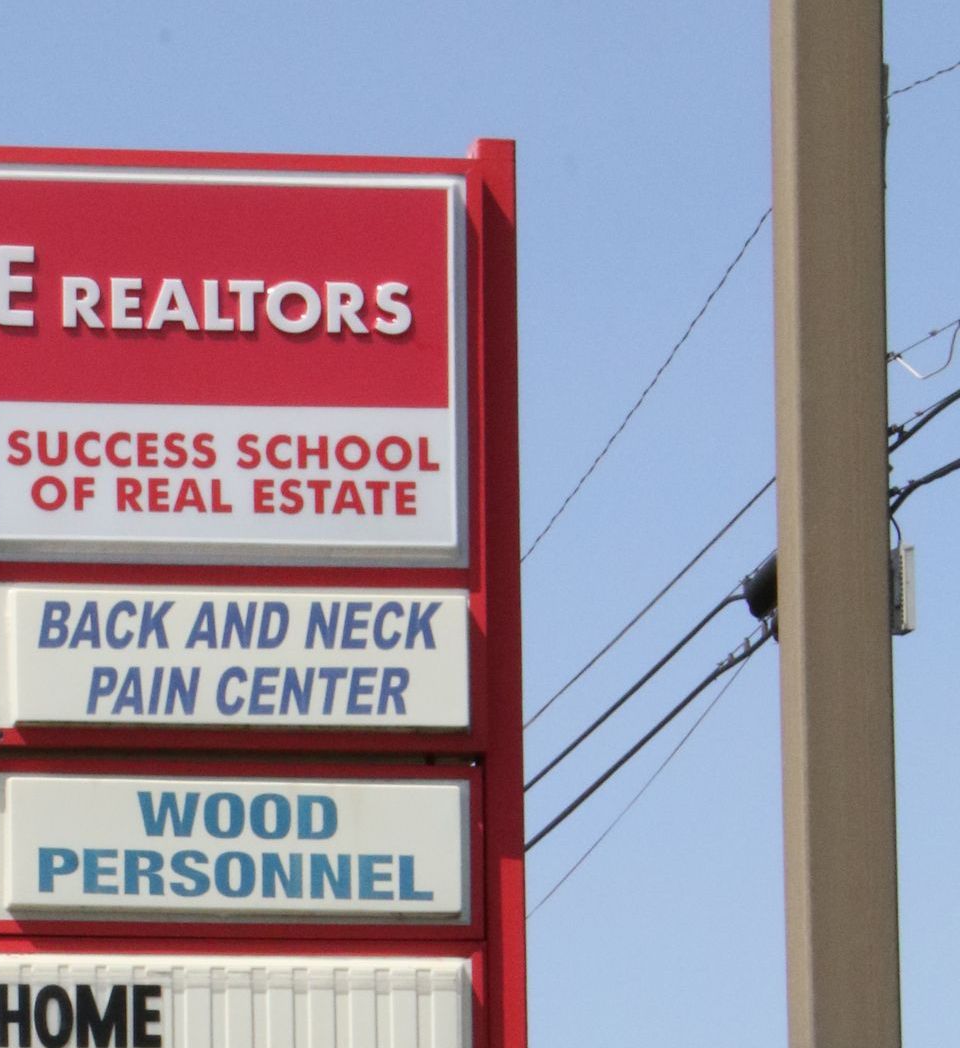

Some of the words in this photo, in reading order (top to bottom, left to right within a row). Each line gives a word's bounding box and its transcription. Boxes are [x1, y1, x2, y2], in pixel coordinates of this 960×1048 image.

[62, 277, 411, 334] REALTORS
[8, 430, 217, 469] SUCCESS
[237, 434, 439, 471] SCHOOL
[31, 476, 94, 511] OF
[116, 477, 232, 513] REAL
[253, 479, 416, 515] ESTATE
[38, 601, 171, 649] BACK
[186, 602, 288, 649] AND
[305, 602, 438, 649] NECK
[86, 667, 198, 715] PAIN
[216, 666, 408, 715] CENTER
[138, 791, 337, 840] WOOD
[39, 848, 433, 901] PERSONNEL
